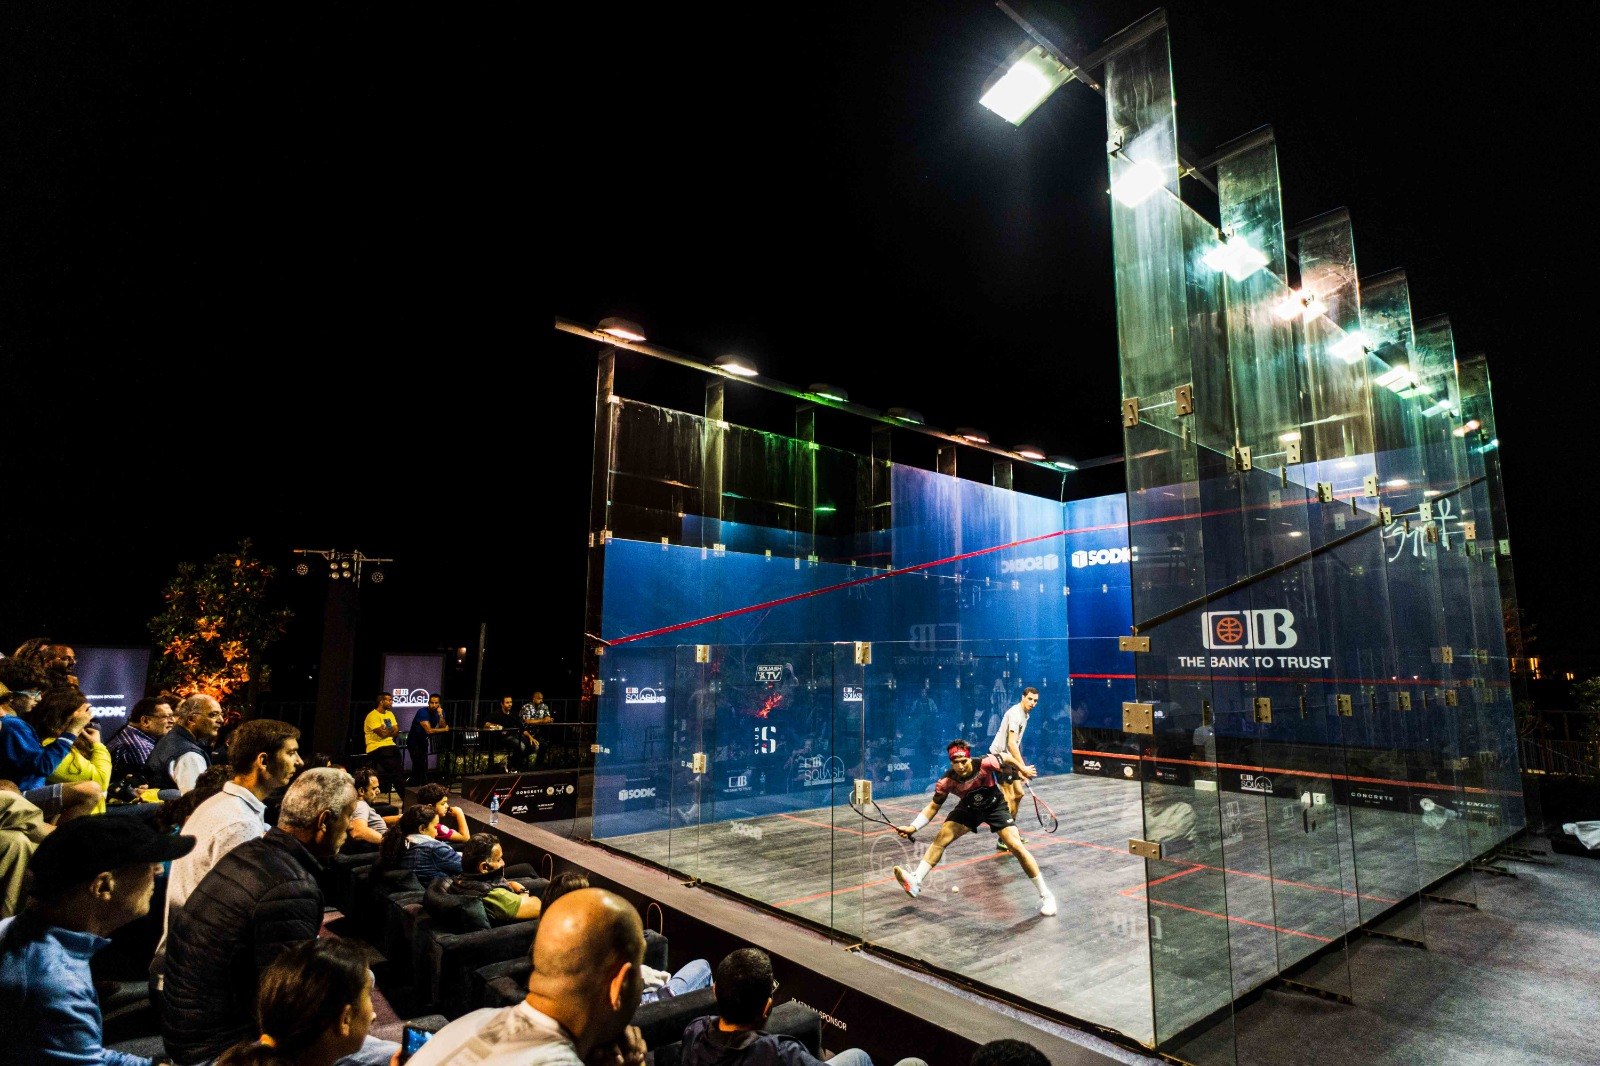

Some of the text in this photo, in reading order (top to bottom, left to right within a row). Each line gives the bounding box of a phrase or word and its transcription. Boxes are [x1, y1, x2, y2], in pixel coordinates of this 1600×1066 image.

[1089, 547, 1138, 565] SODIC
[1178, 656, 1331, 669] THE BANK TO TRUST
[766, 672, 780, 680] TV
[761, 726, 777, 754] S
[1083, 760, 1101, 768] PSA
[628, 787, 656, 799] SODIC
[1351, 792, 1394, 801] CONCRETE
[819, 1011, 847, 1031] SPONSOR
